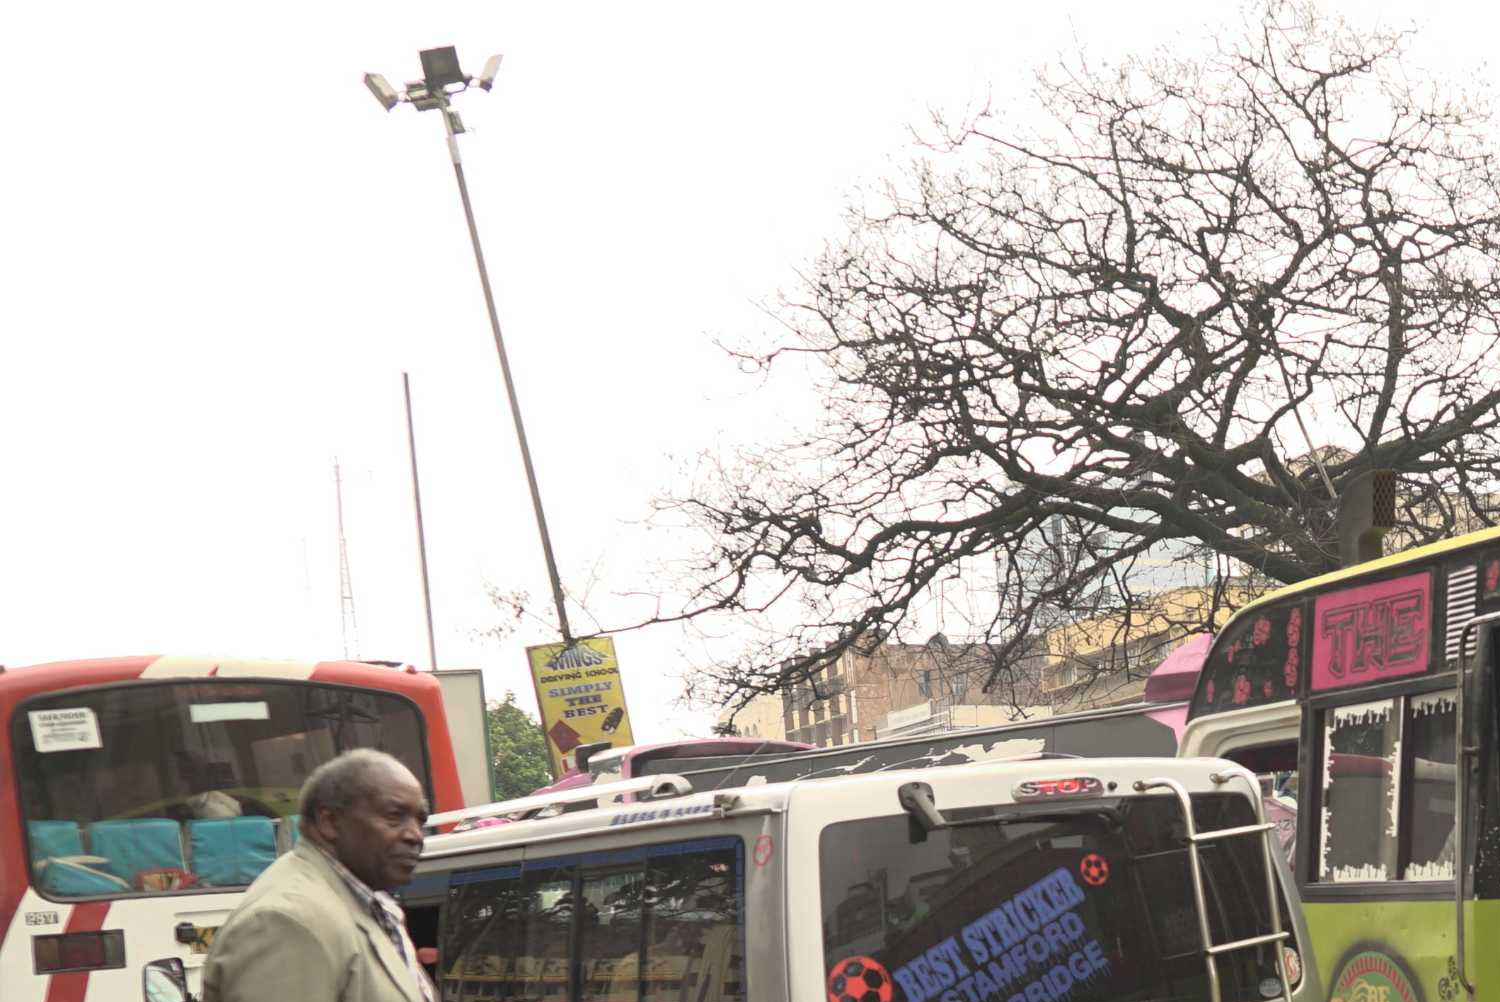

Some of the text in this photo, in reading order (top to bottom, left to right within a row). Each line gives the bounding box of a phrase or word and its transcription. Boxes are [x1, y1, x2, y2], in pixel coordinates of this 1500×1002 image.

[1321, 588, 1425, 679] THE
[546, 645, 605, 671] WINGS
[541, 671, 583, 684] DRIVING
[549, 681, 612, 697] SIMPLY
[565, 694, 603, 707] THE
[563, 704, 609, 719] BEST
[1019, 779, 1098, 797] STOP
